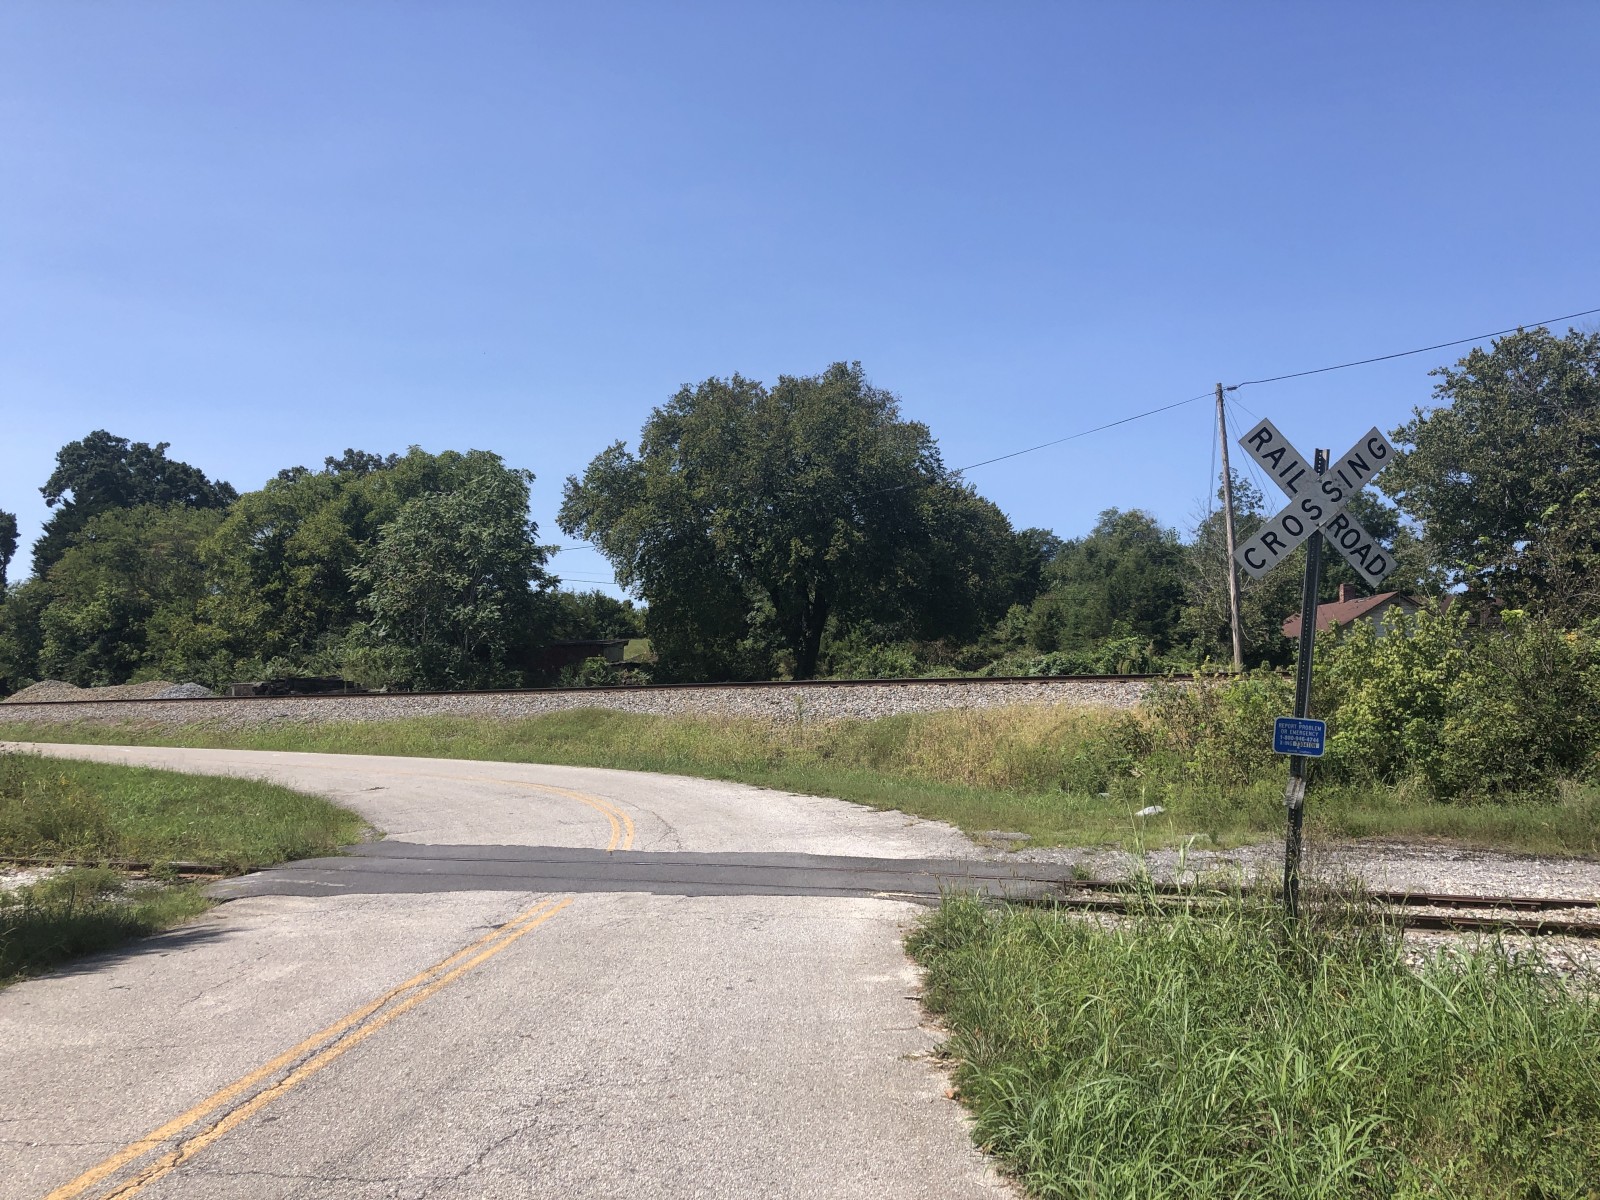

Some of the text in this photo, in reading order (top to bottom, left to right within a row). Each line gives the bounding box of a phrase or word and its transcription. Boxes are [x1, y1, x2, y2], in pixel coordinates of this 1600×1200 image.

[1248, 427, 1306, 494] RAIL
[1244, 437, 1387, 570] CROSSING
[1326, 513, 1387, 576] ROAD
[1298, 724, 1322, 732] PROBLEM
